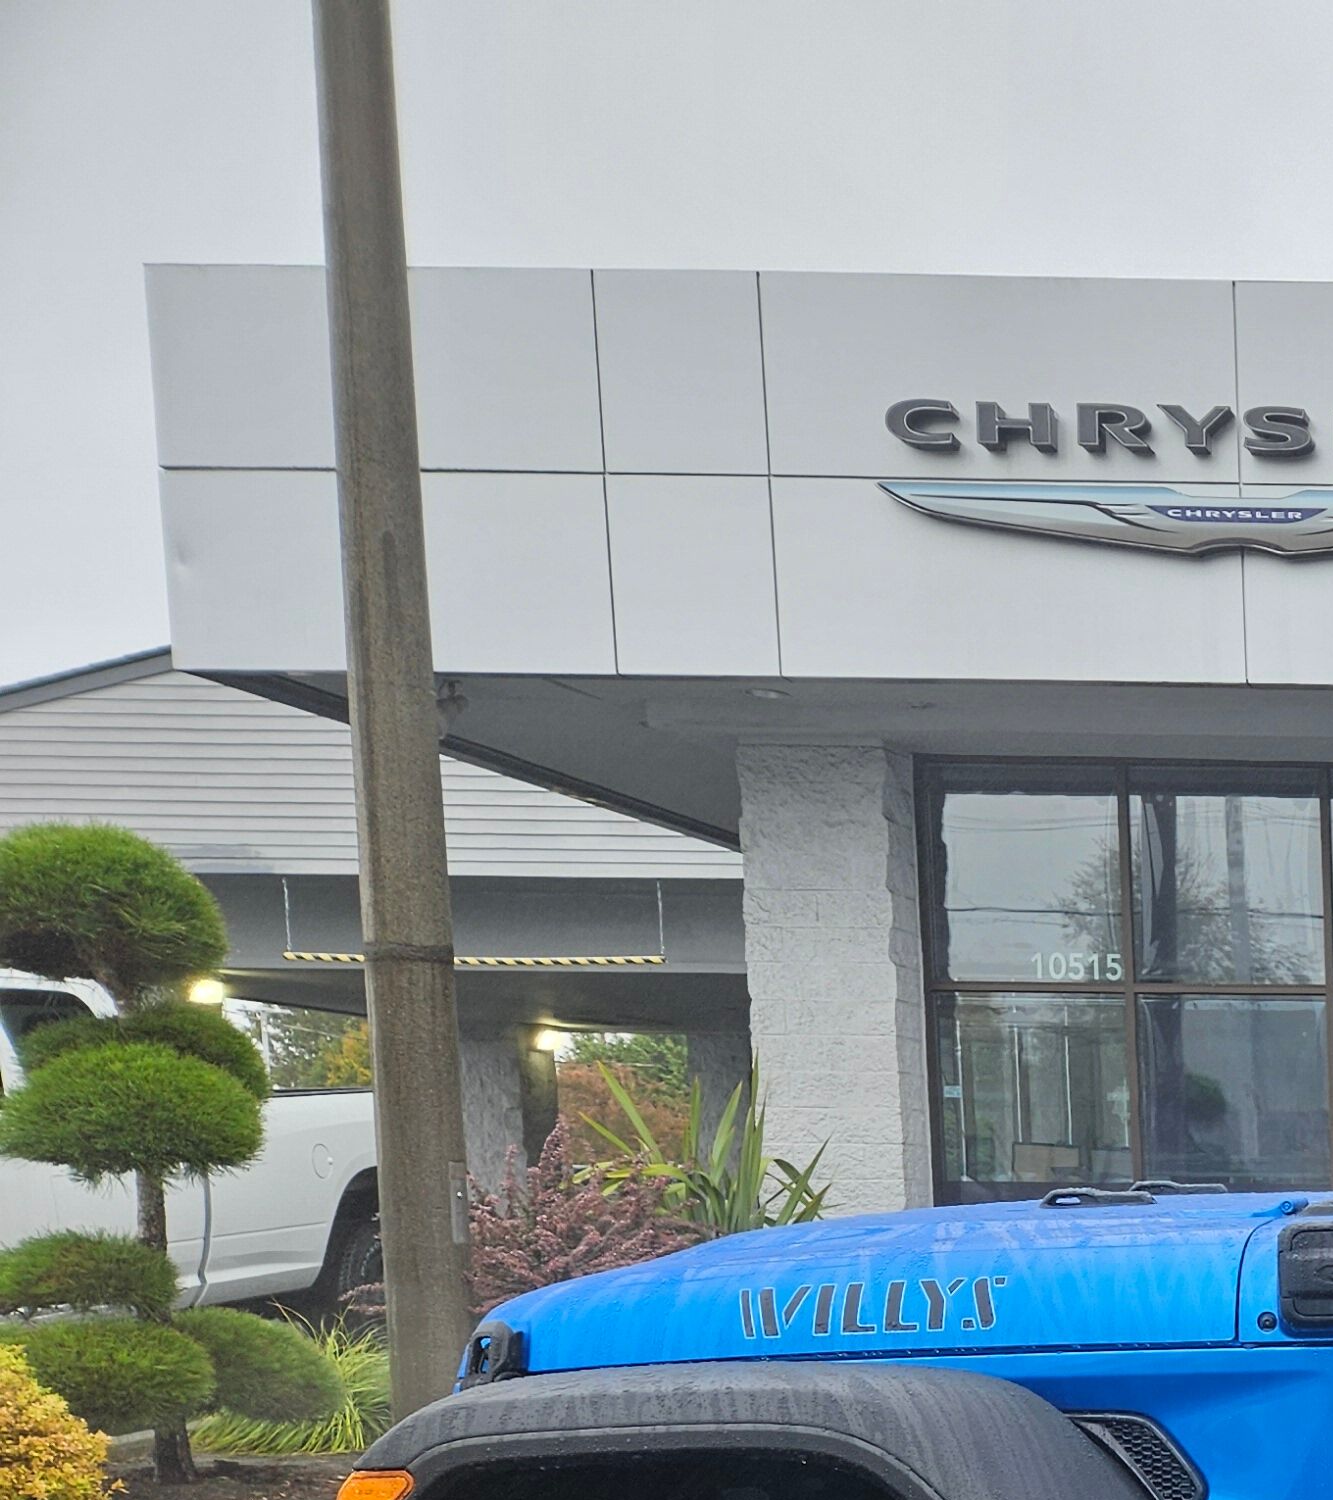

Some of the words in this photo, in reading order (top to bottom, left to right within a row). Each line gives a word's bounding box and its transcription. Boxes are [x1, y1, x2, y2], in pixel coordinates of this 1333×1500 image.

[1167, 508, 1303, 520] CHRYSLER
[1031, 952, 1122, 981] 10515
[739, 1276, 1007, 1339] WILLYS
